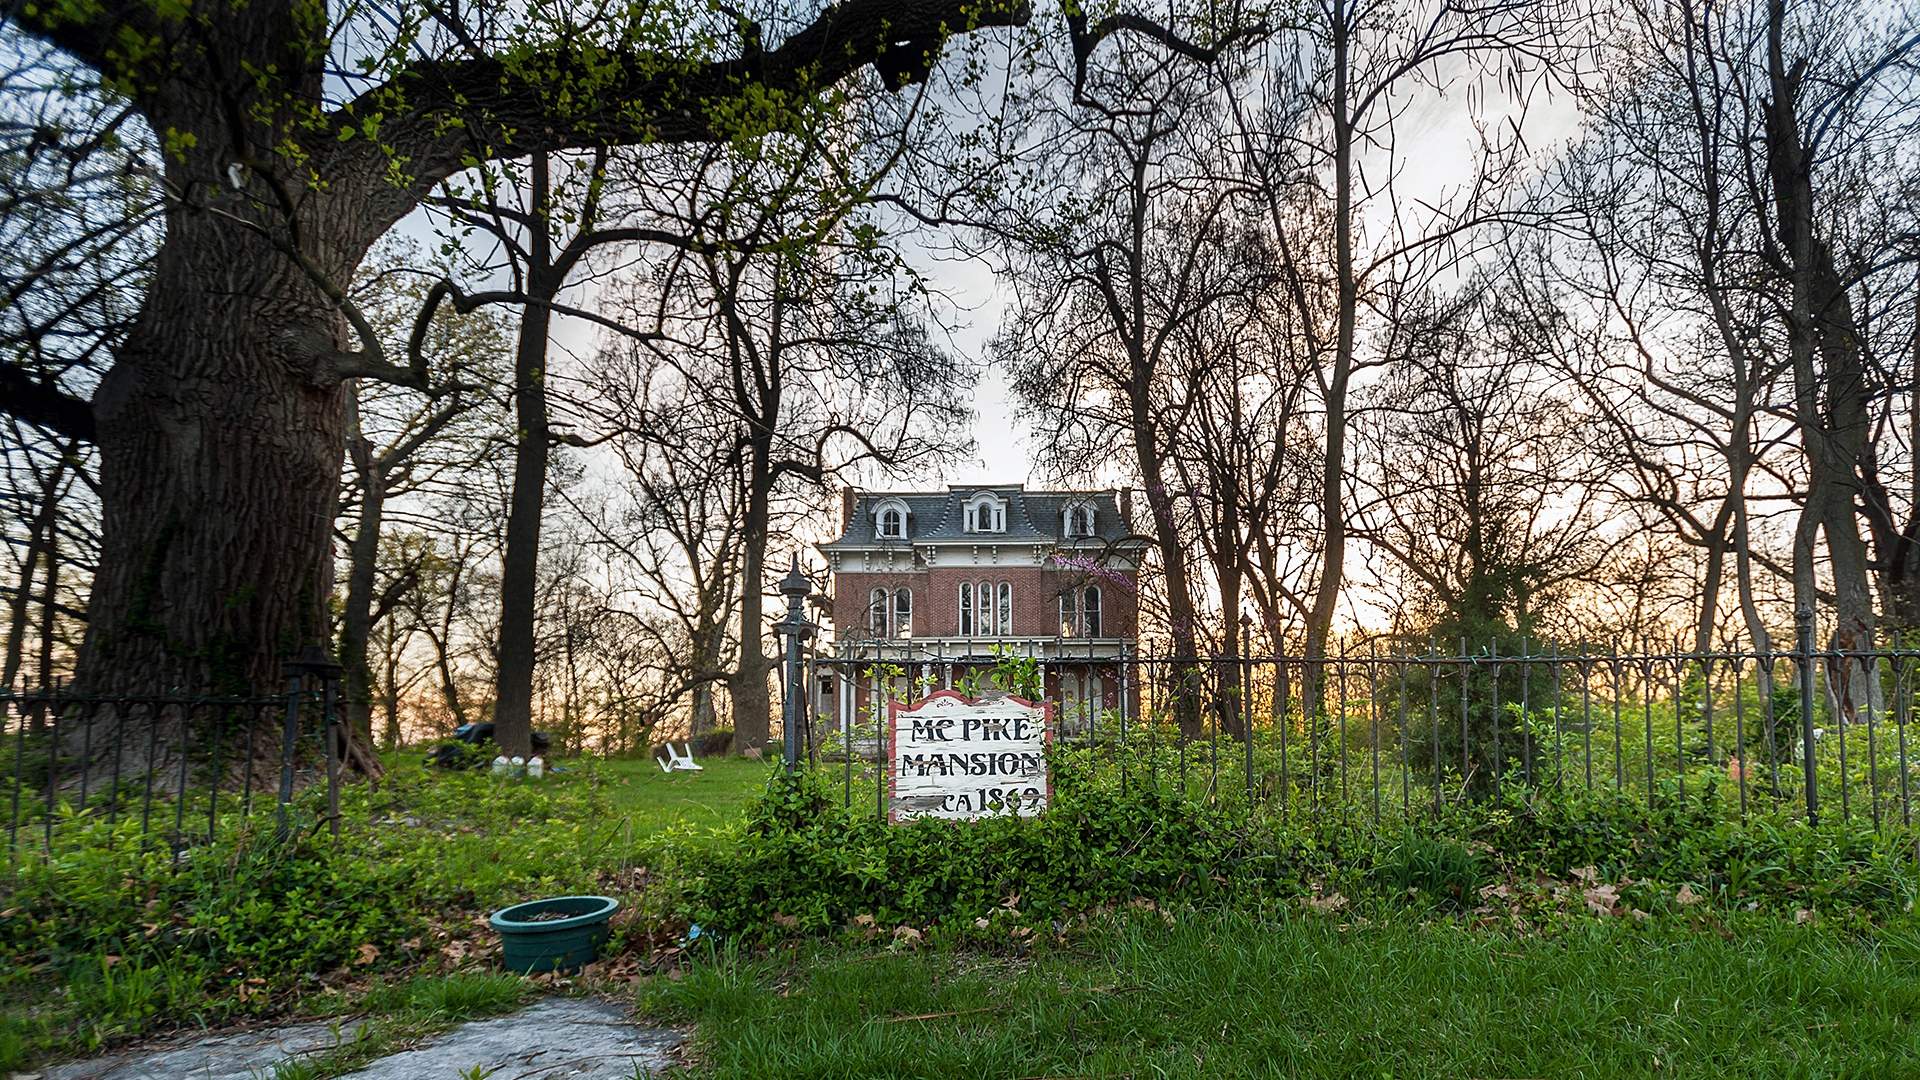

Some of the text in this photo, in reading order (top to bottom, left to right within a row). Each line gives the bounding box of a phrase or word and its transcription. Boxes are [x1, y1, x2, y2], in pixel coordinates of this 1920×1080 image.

[912, 718, 1031, 742] MC PIKE
[902, 753, 1041, 776] MANSION
